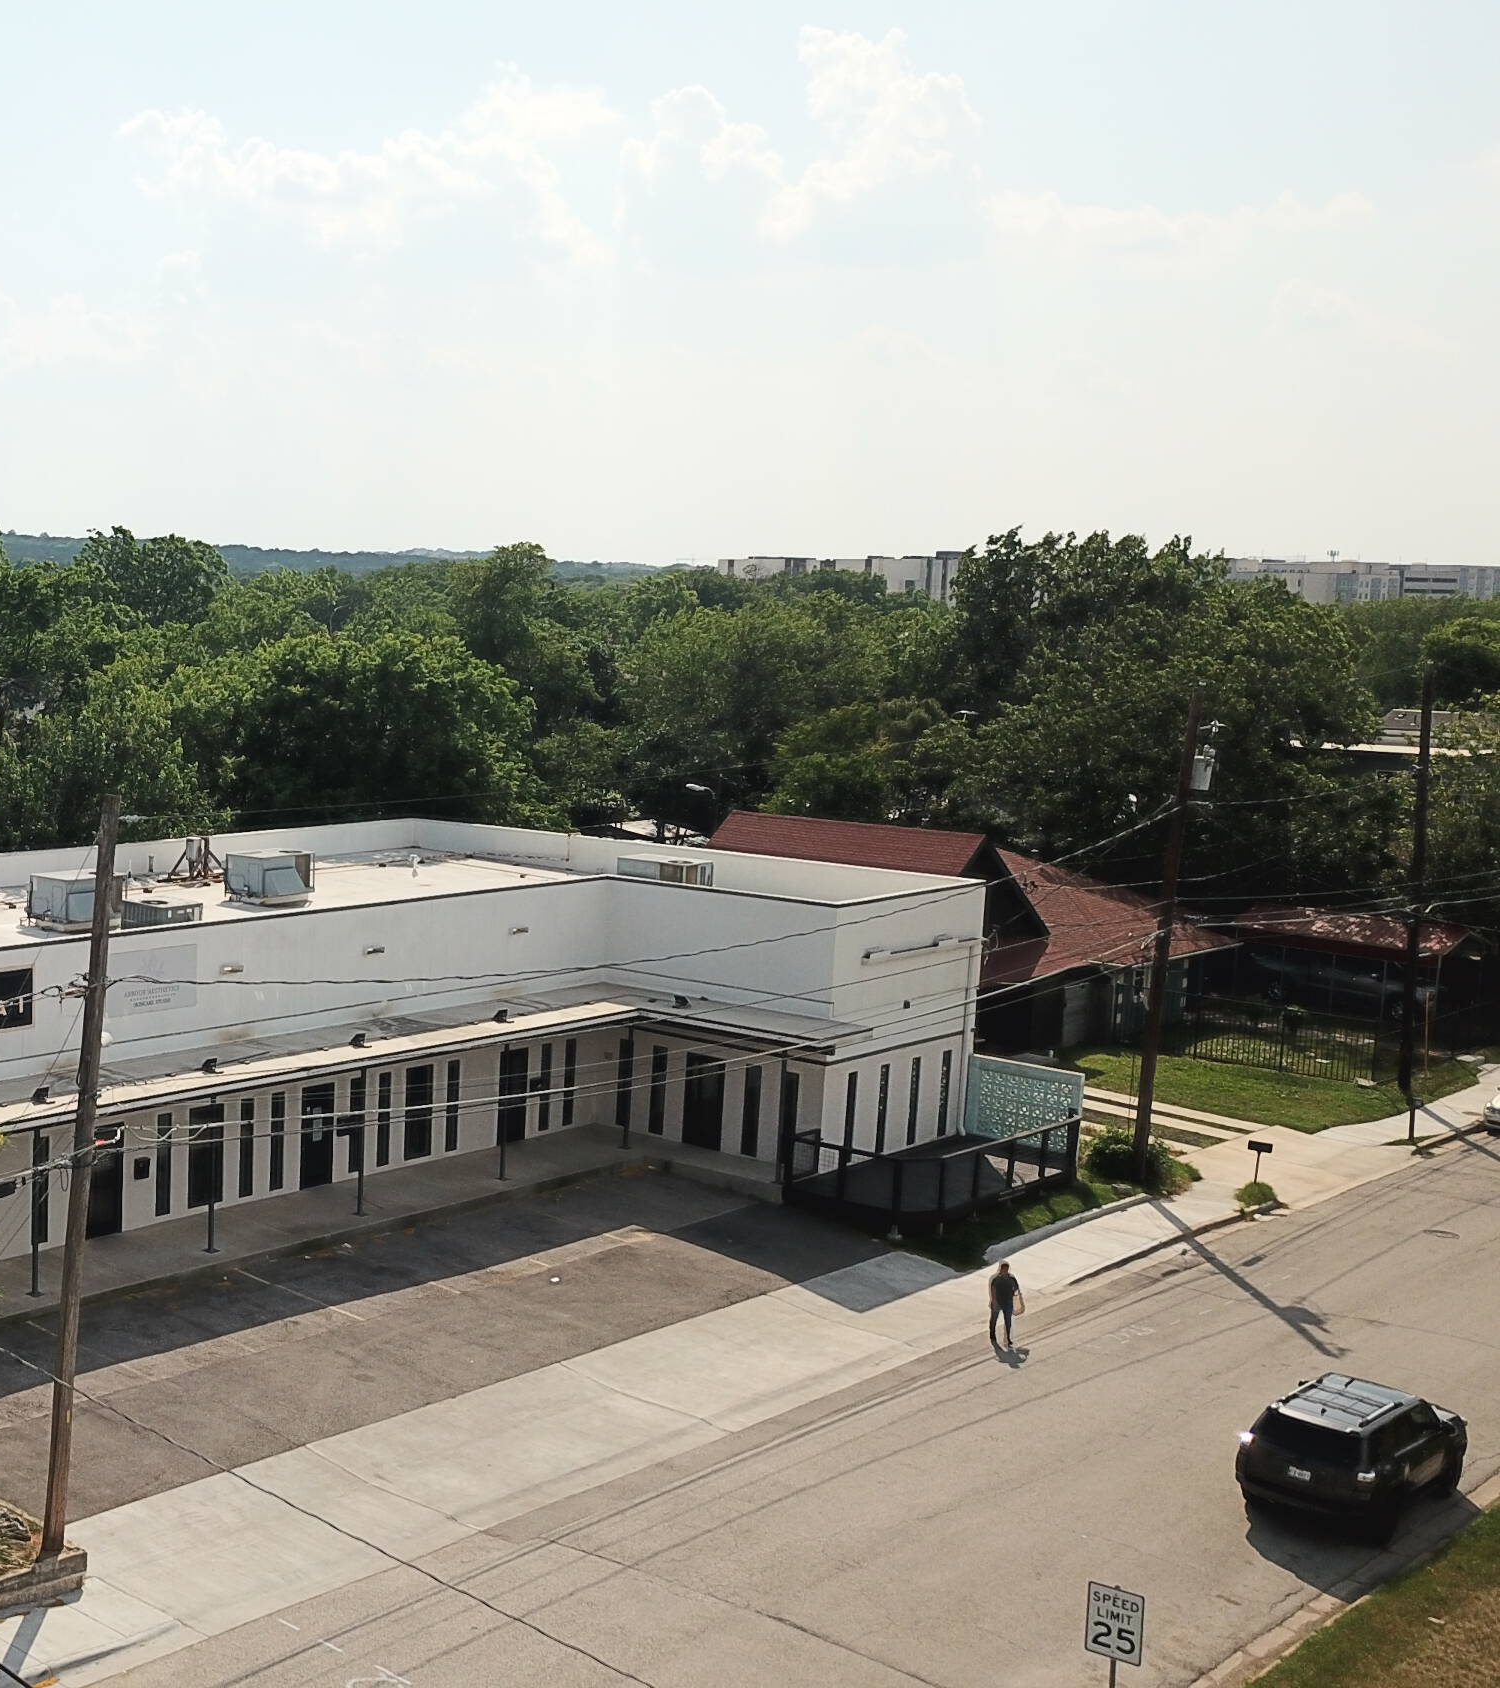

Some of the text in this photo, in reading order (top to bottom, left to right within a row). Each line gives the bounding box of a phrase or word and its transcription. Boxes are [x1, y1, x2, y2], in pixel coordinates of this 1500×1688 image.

[1092, 1591, 1140, 1613] SPEED
[1097, 1607, 1133, 1626] LIMIT
[1091, 1621, 1136, 1655] 25
